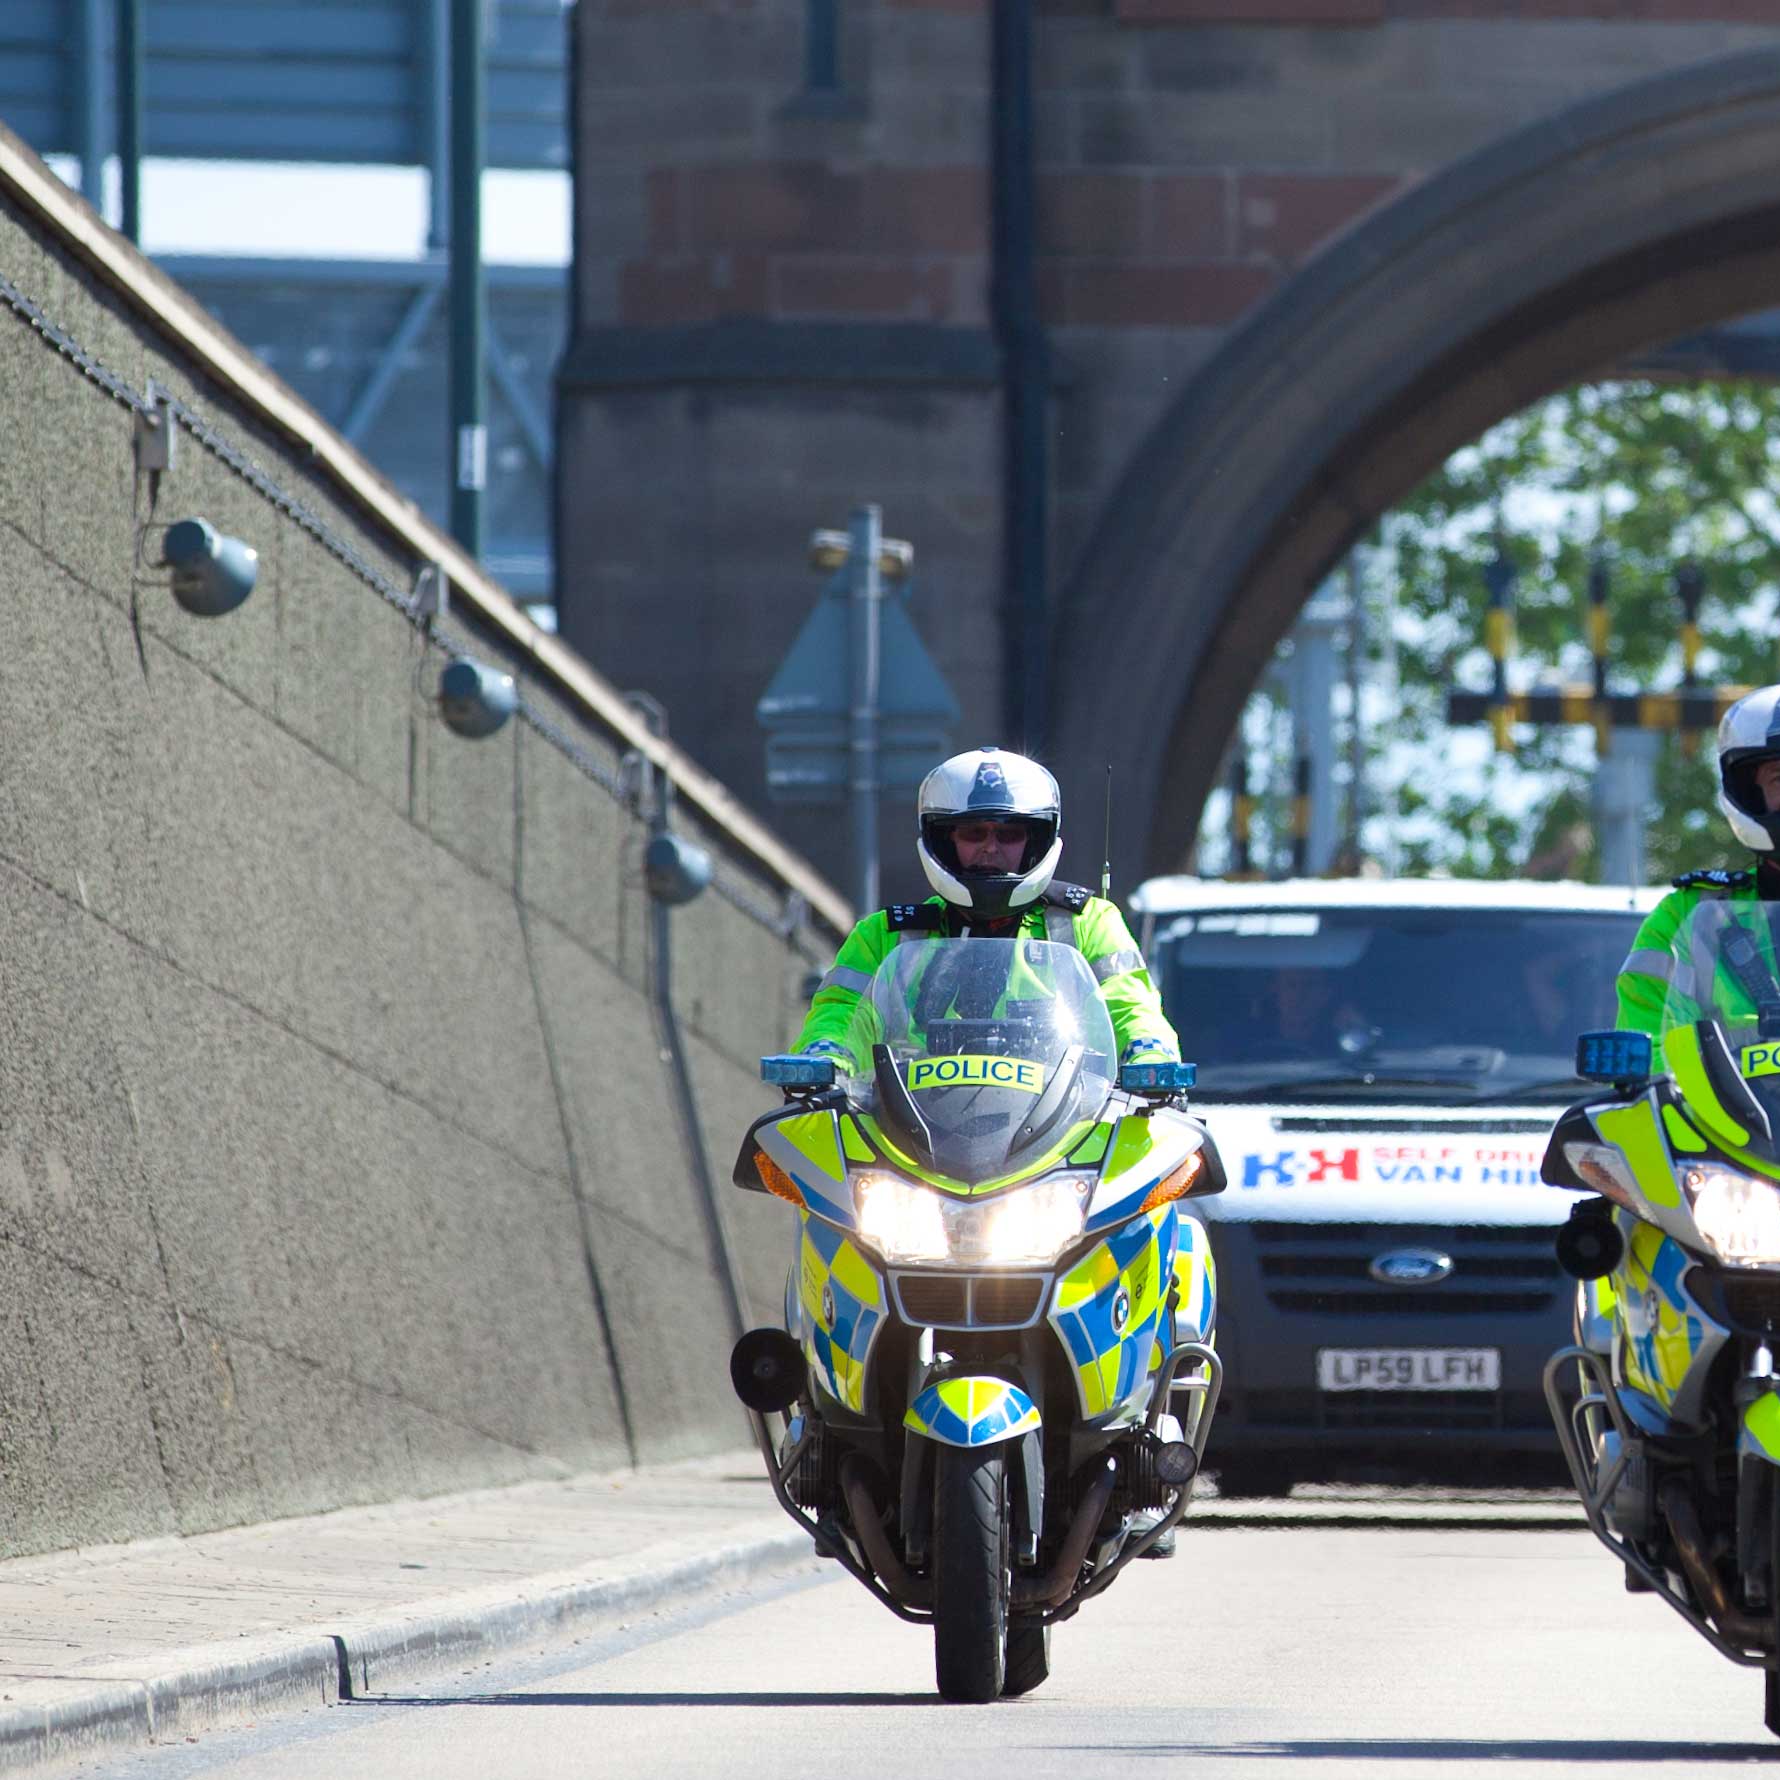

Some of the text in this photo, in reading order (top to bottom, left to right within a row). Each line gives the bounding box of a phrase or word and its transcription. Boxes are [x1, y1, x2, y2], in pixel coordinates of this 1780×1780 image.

[915, 1060, 1035, 1086] POLICE
[1374, 1147, 1454, 1161] SELF
[1375, 1165, 1462, 1184] VAN
[1333, 1357, 1485, 1383] LP59 LFH
